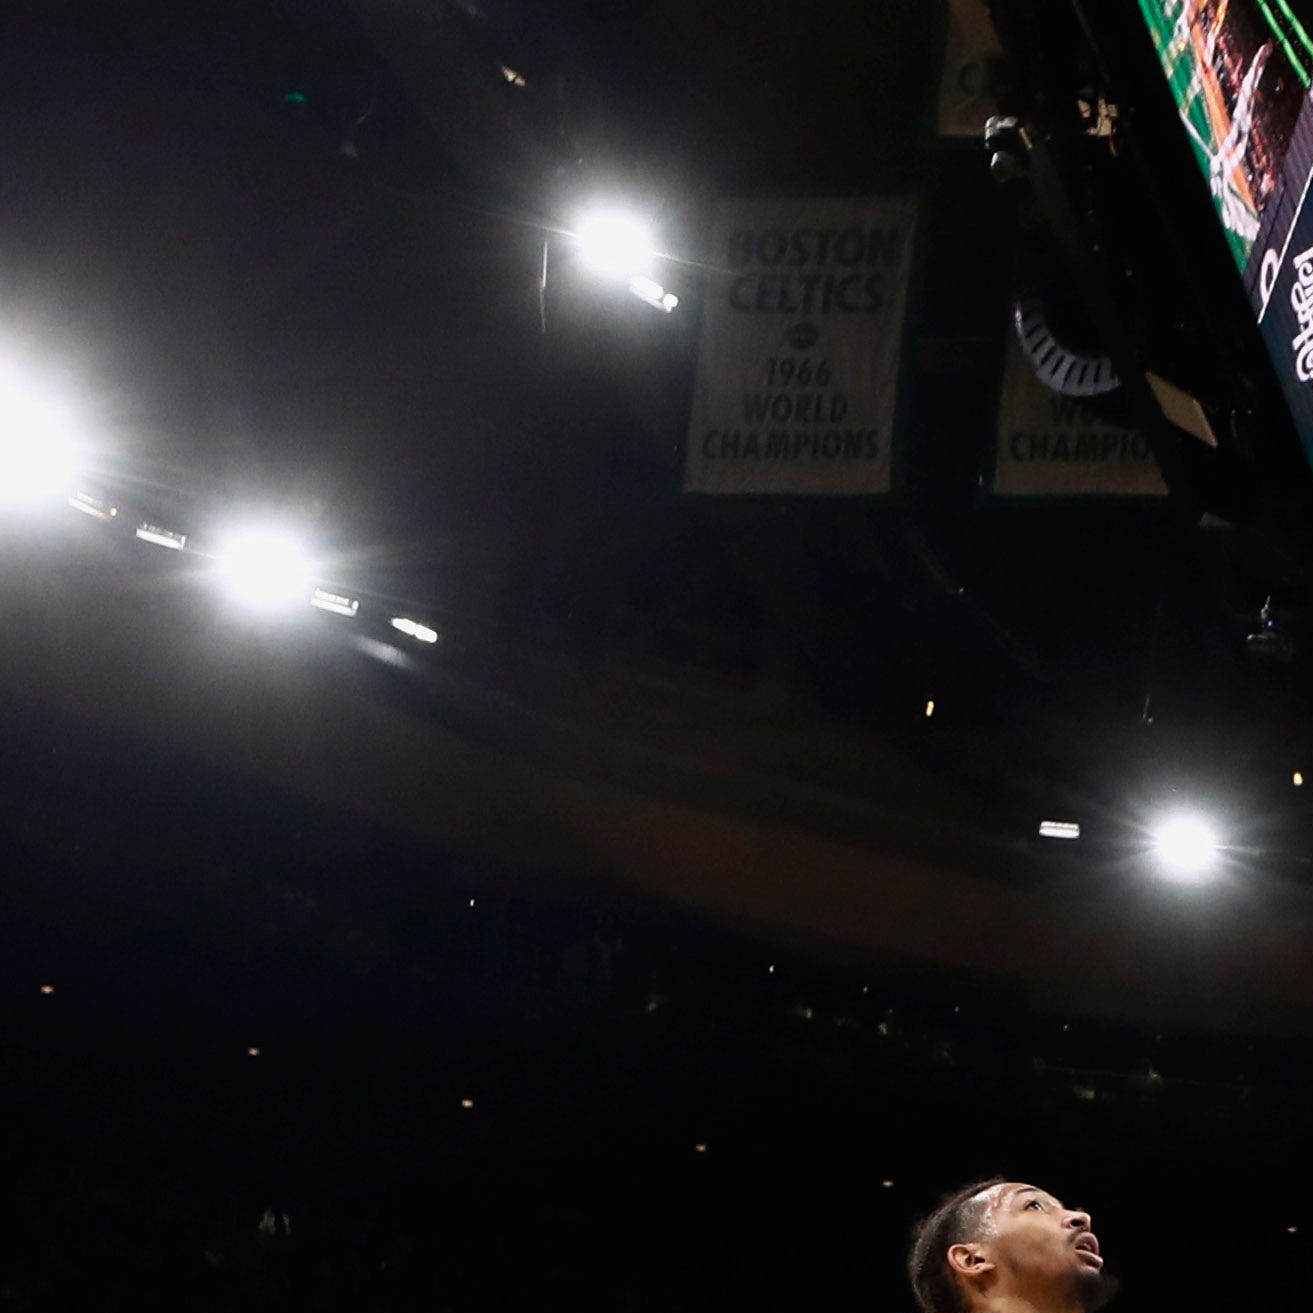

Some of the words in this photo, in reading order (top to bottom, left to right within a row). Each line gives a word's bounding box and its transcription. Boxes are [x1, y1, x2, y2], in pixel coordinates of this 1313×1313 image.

[729, 229, 900, 267] BOSTON
[729, 274, 883, 314] CELTICS
[703, 430, 880, 460] CHAMPIONS
[1010, 431, 1149, 462] CHAMPIO
